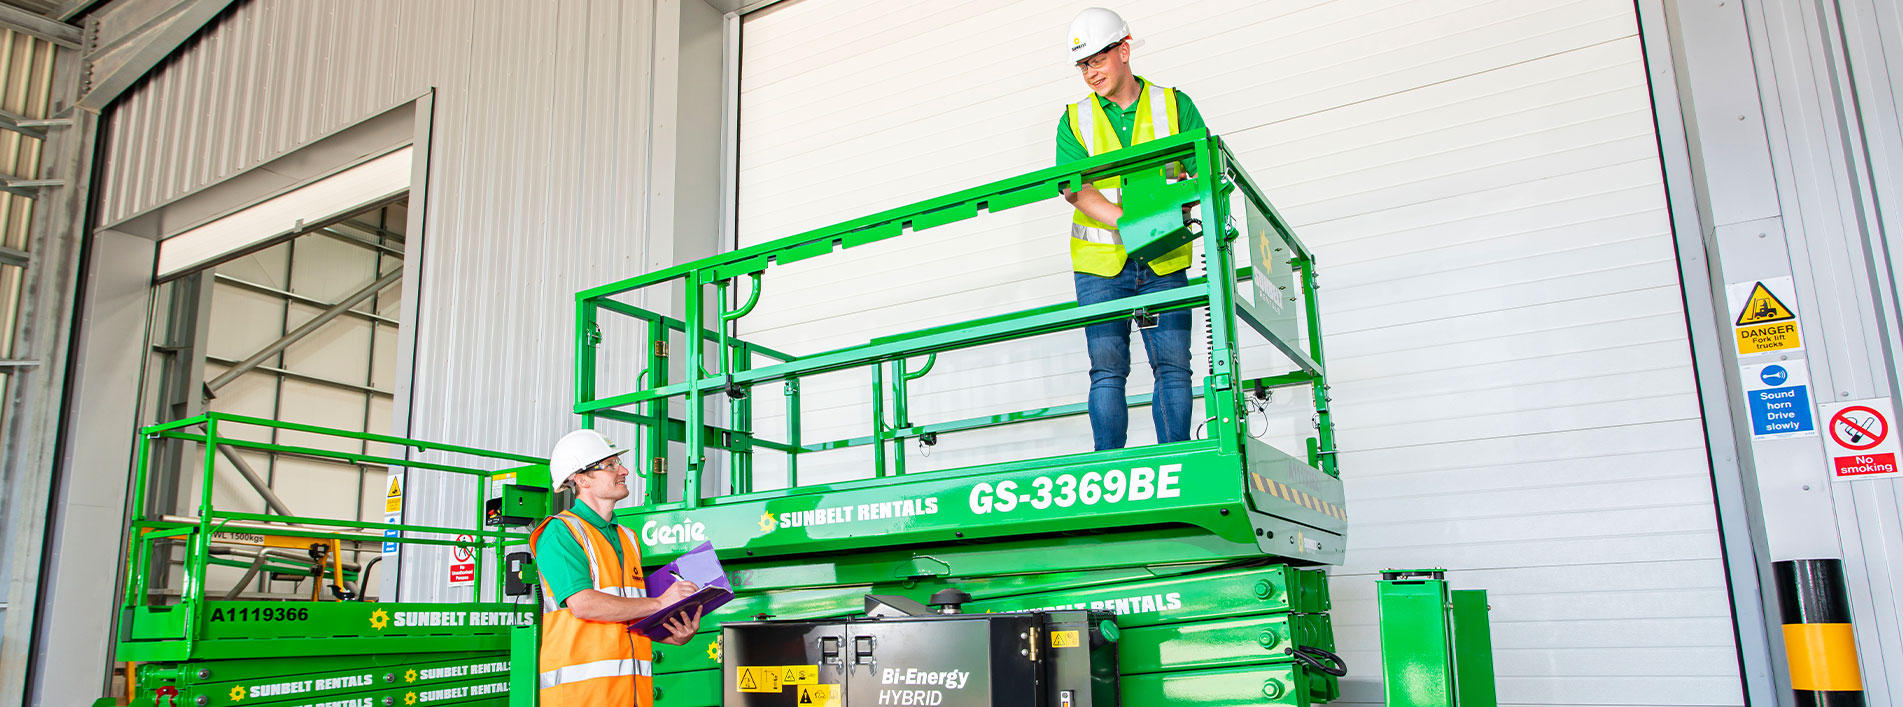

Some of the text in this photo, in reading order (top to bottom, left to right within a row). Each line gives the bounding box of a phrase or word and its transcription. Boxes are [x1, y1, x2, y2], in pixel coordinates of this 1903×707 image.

[1741, 324, 1795, 339] DANGER
[1752, 336, 1772, 344] Fork
[1756, 341, 1784, 350] trucks
[1760, 389, 1795, 400] Sound
[1766, 401, 1792, 410] horn
[1767, 411, 1796, 421] Drive
[1766, 421, 1800, 431] slowly
[1855, 456, 1874, 465] No
[1841, 463, 1893, 474] smoking
[968, 463, 1183, 515] GS-3369BE
[780, 497, 938, 529] SUNBELT RENTALS
[211, 531, 264, 543] WL 1500kgs
[641, 517, 706, 547] Genie
[210, 608, 309, 622] A1119366
[393, 611, 534, 627] SUNBELT RENTALS
[419, 665, 469, 681] SUNBELT
[881, 668, 970, 690] Bi-Energy
[249, 674, 373, 698] SUNBELT RENTALS
[419, 686, 469, 703] SUNBELT
[878, 689, 943, 706] HYBRID
